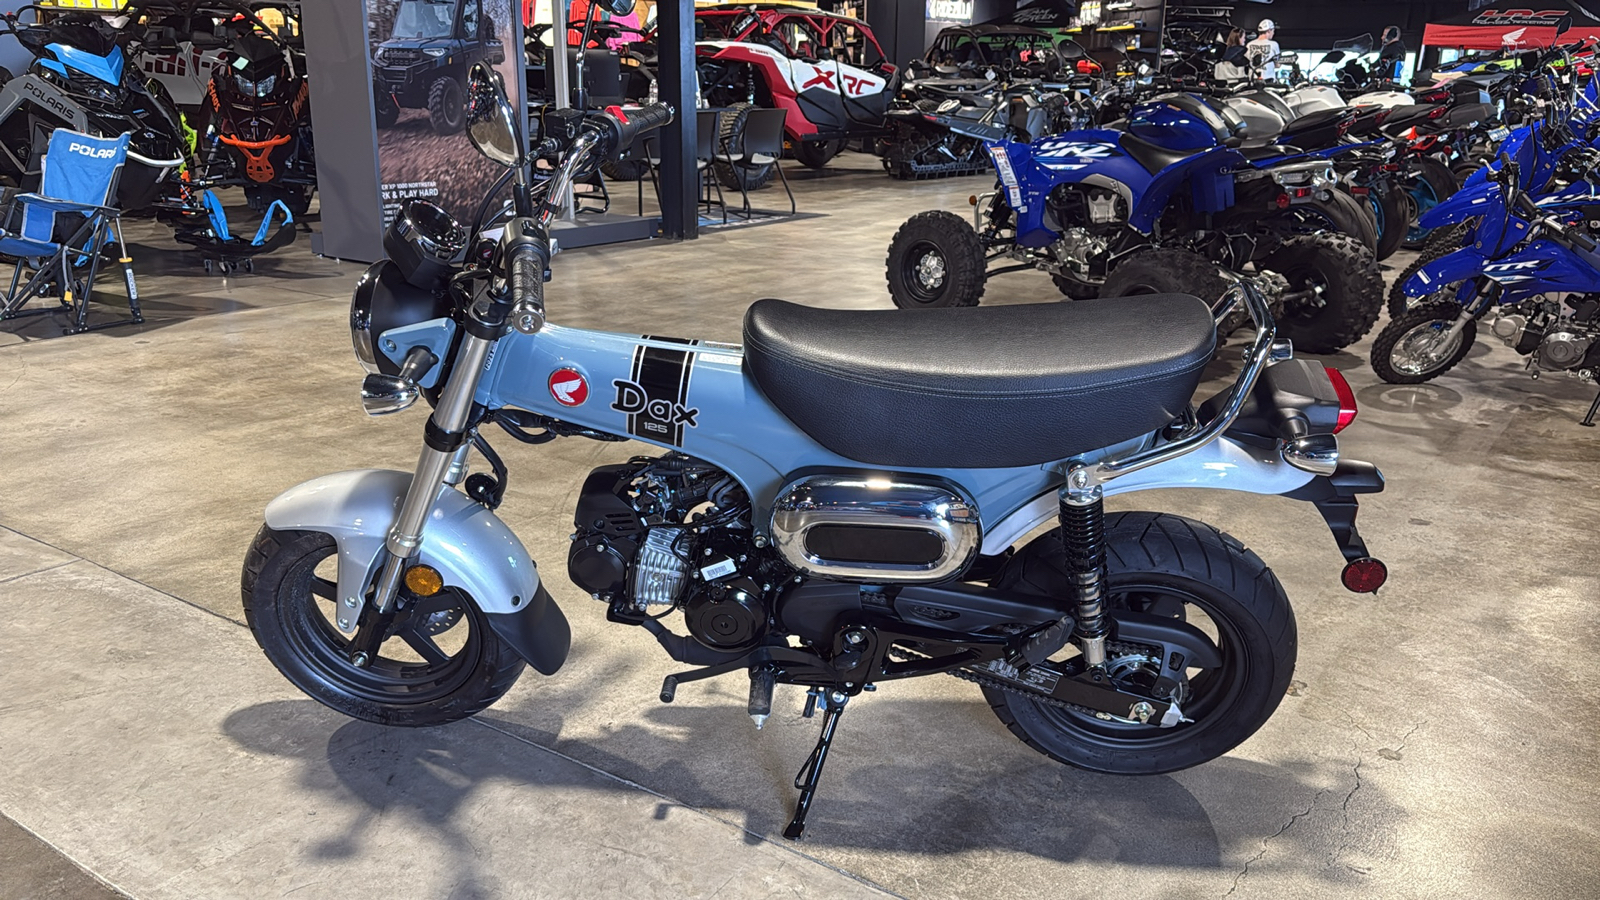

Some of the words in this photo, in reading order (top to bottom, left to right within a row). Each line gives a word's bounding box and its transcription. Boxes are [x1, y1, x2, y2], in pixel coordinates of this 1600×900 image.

[23, 82, 76, 120] POLARIS
[69, 142, 117, 159] POLAR
[399, 190, 418, 199] PLAY
[418, 188, 439, 197] HARD
[609, 377, 700, 429] Dax
[643, 421, 668, 434] 125
